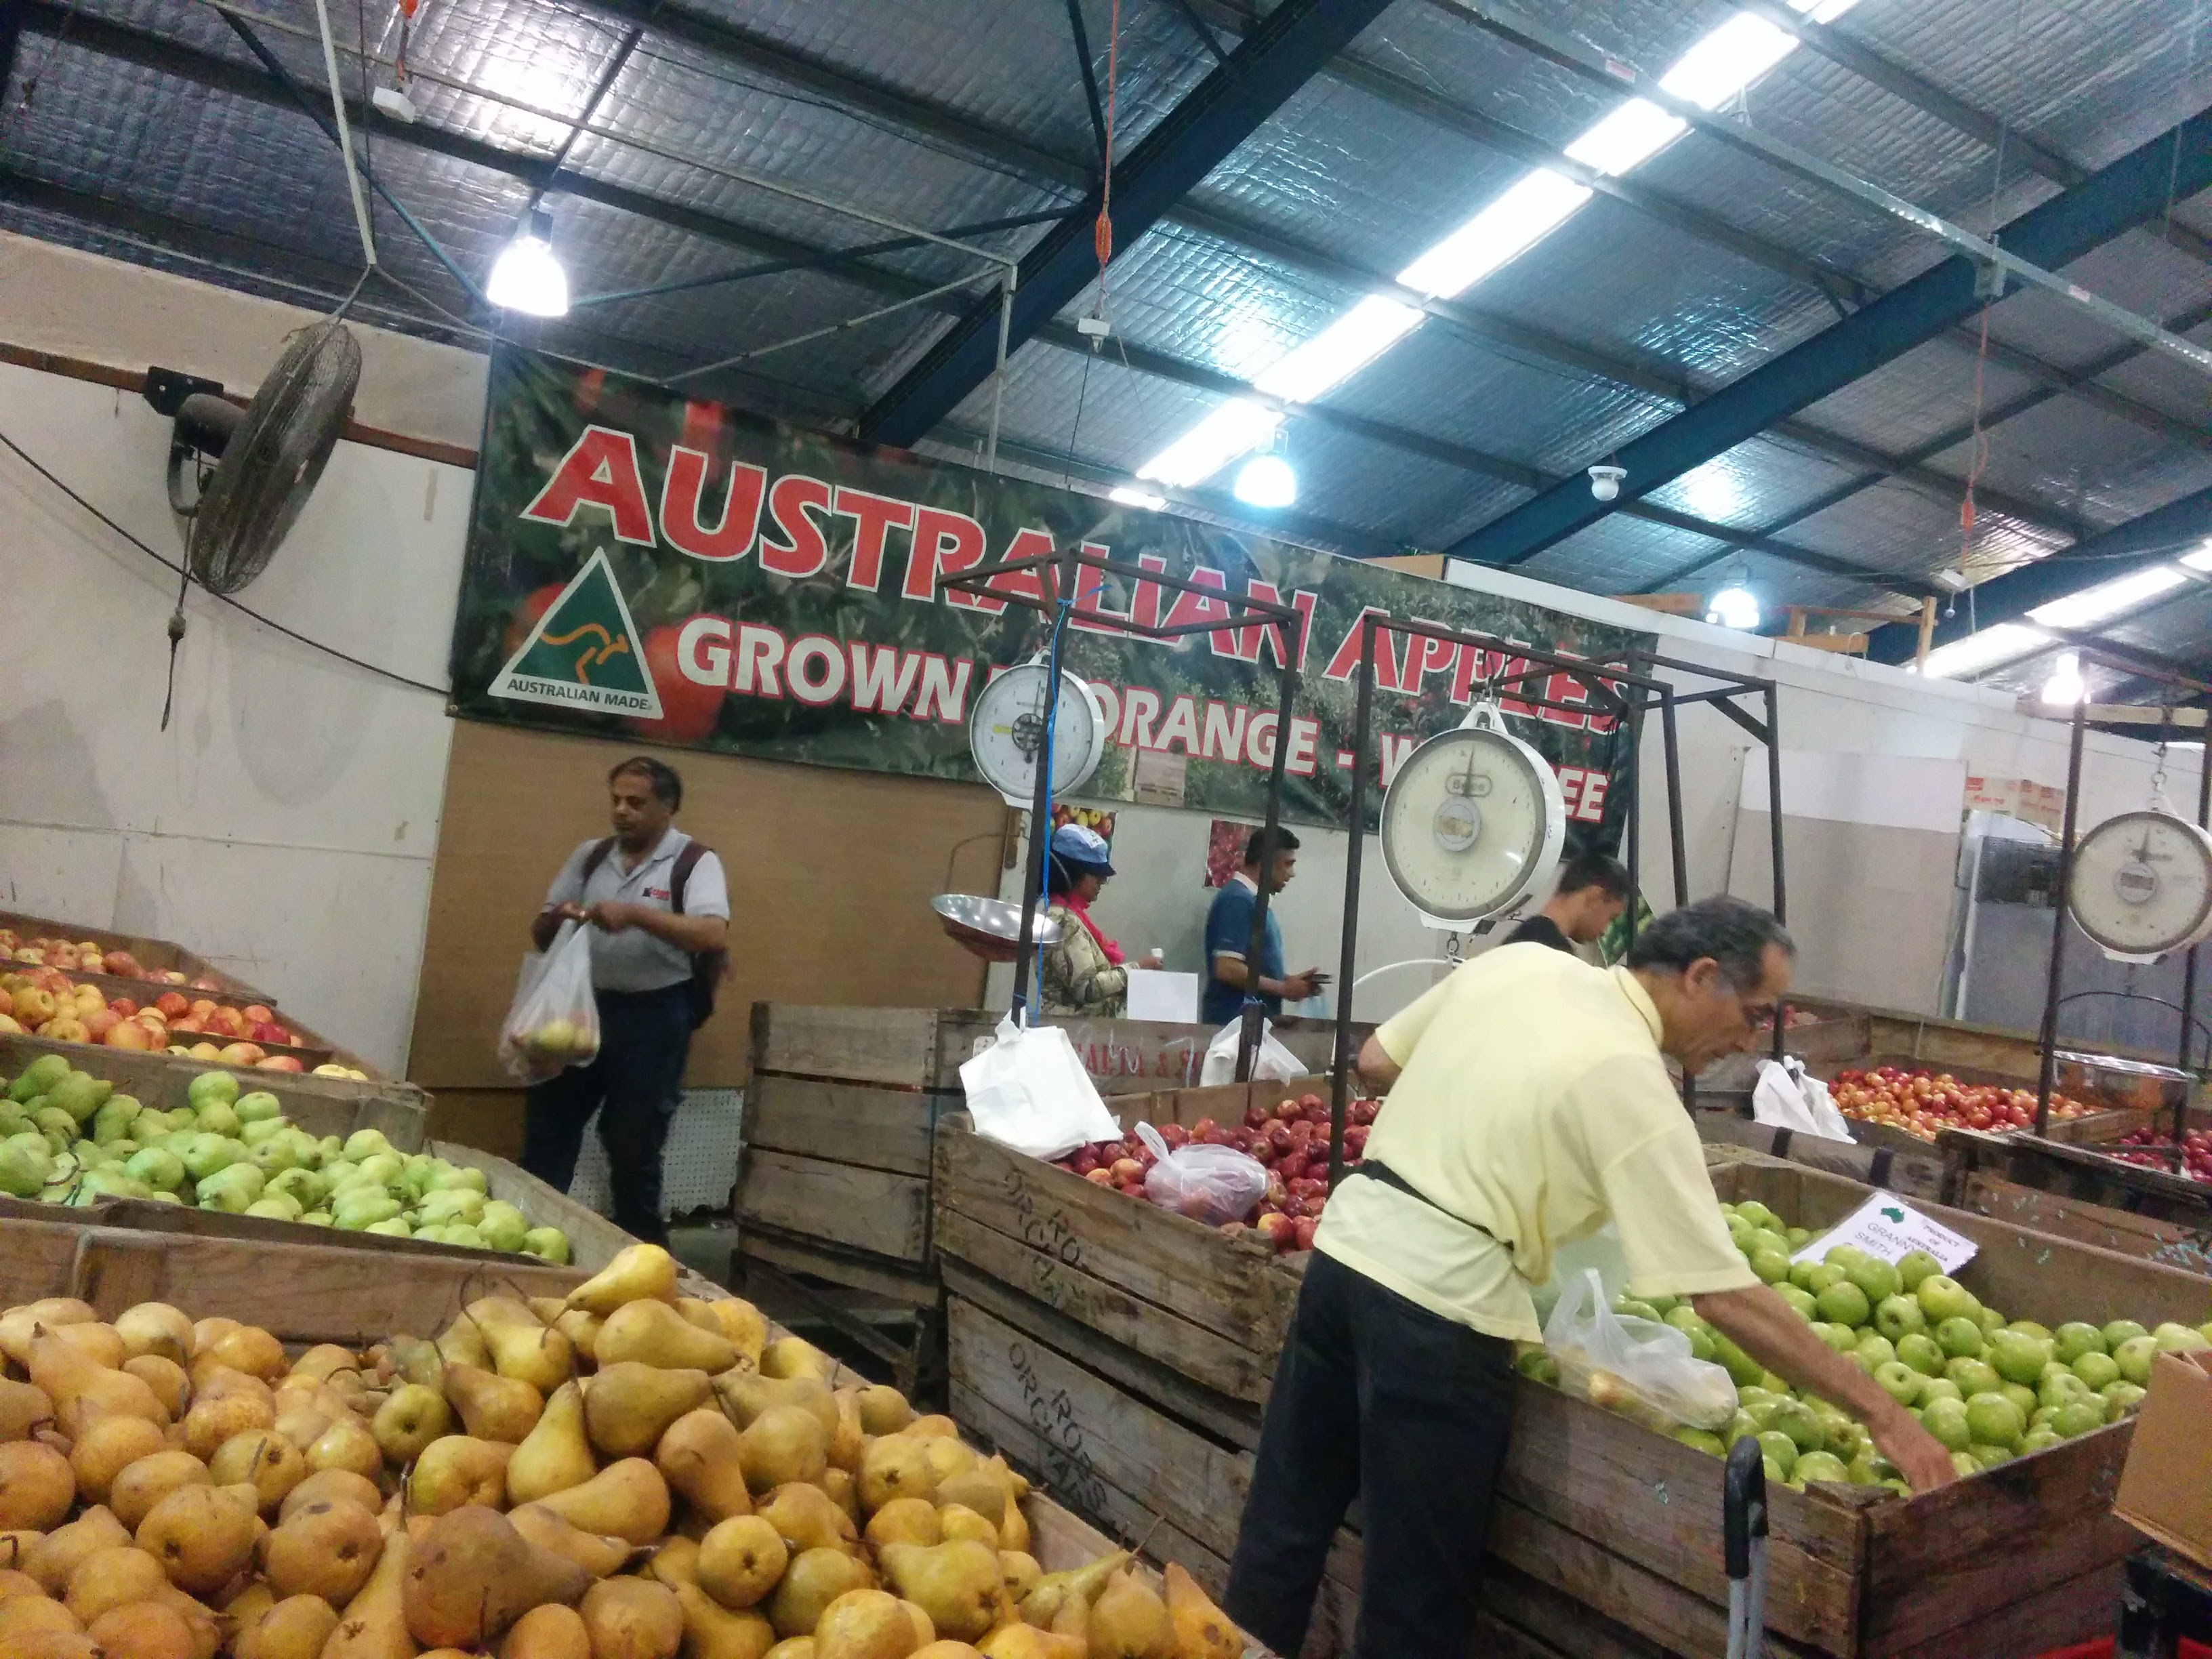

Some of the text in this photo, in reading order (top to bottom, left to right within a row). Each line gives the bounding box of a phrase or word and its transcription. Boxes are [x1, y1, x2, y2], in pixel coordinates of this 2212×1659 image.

[519, 424, 1629, 735] AUSTRALIAN APPLES
[507, 678, 649, 710] AUSTRALIAN MADE
[677, 613, 975, 725] GROWN
[1854, 1231, 1892, 1255] SMITH
